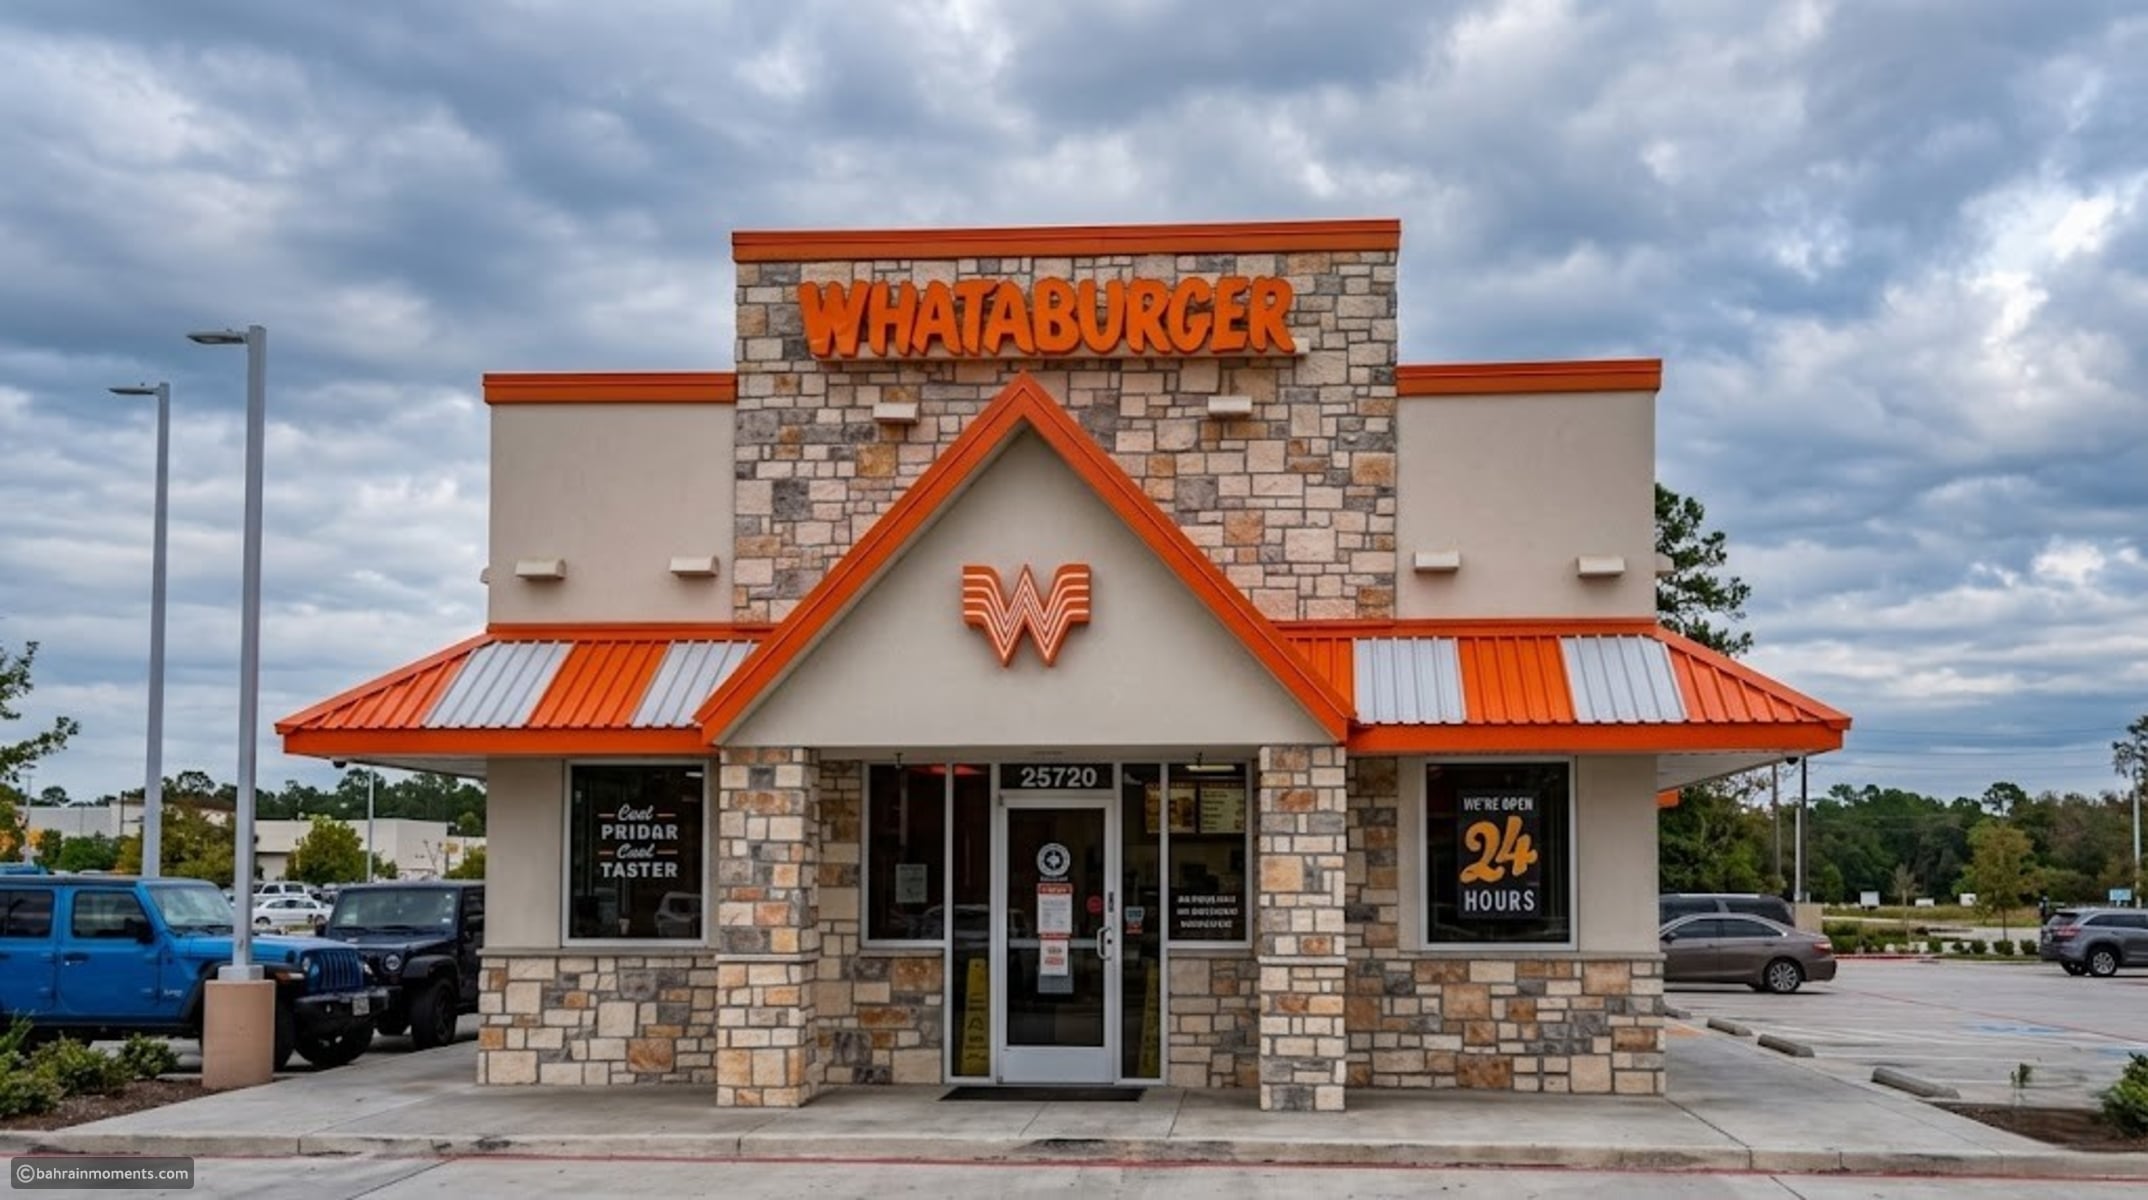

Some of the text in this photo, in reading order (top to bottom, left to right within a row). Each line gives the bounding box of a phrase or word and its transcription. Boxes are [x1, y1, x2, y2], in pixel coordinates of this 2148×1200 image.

[797, 276, 1297, 357] WHATABURGER
[962, 563, 1092, 668] W
[1020, 767, 1098, 788] 25720
[1463, 797, 1534, 811] WE'RE OPEN
[601, 824, 679, 840] PRIDAR
[1459, 815, 1539, 884] 24
[600, 862, 679, 878] TASTER
[1464, 889, 1536, 912] HOURS
